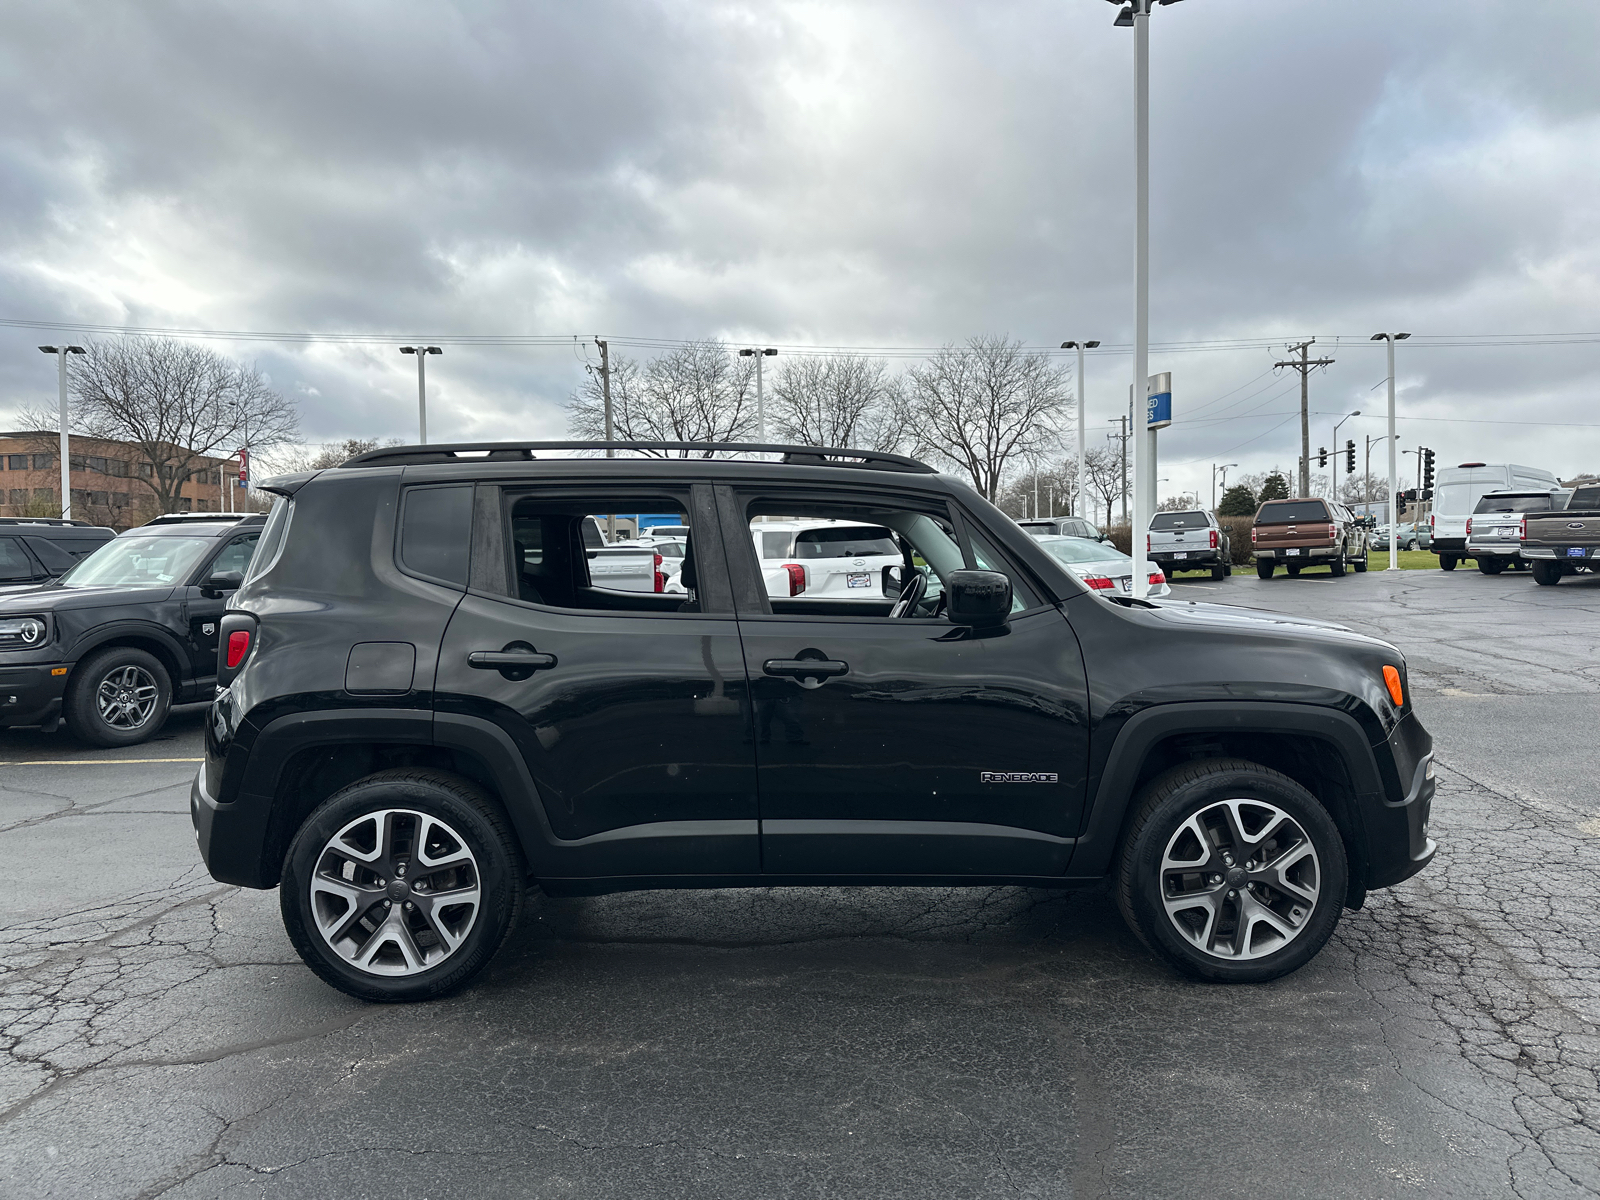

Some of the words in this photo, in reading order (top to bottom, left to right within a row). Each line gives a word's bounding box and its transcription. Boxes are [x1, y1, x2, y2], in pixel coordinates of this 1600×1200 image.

[1147, 398, 1158, 409] ED
[981, 772, 1058, 783] RENEGADE
[1248, 780, 1322, 824] CROSSOVER
